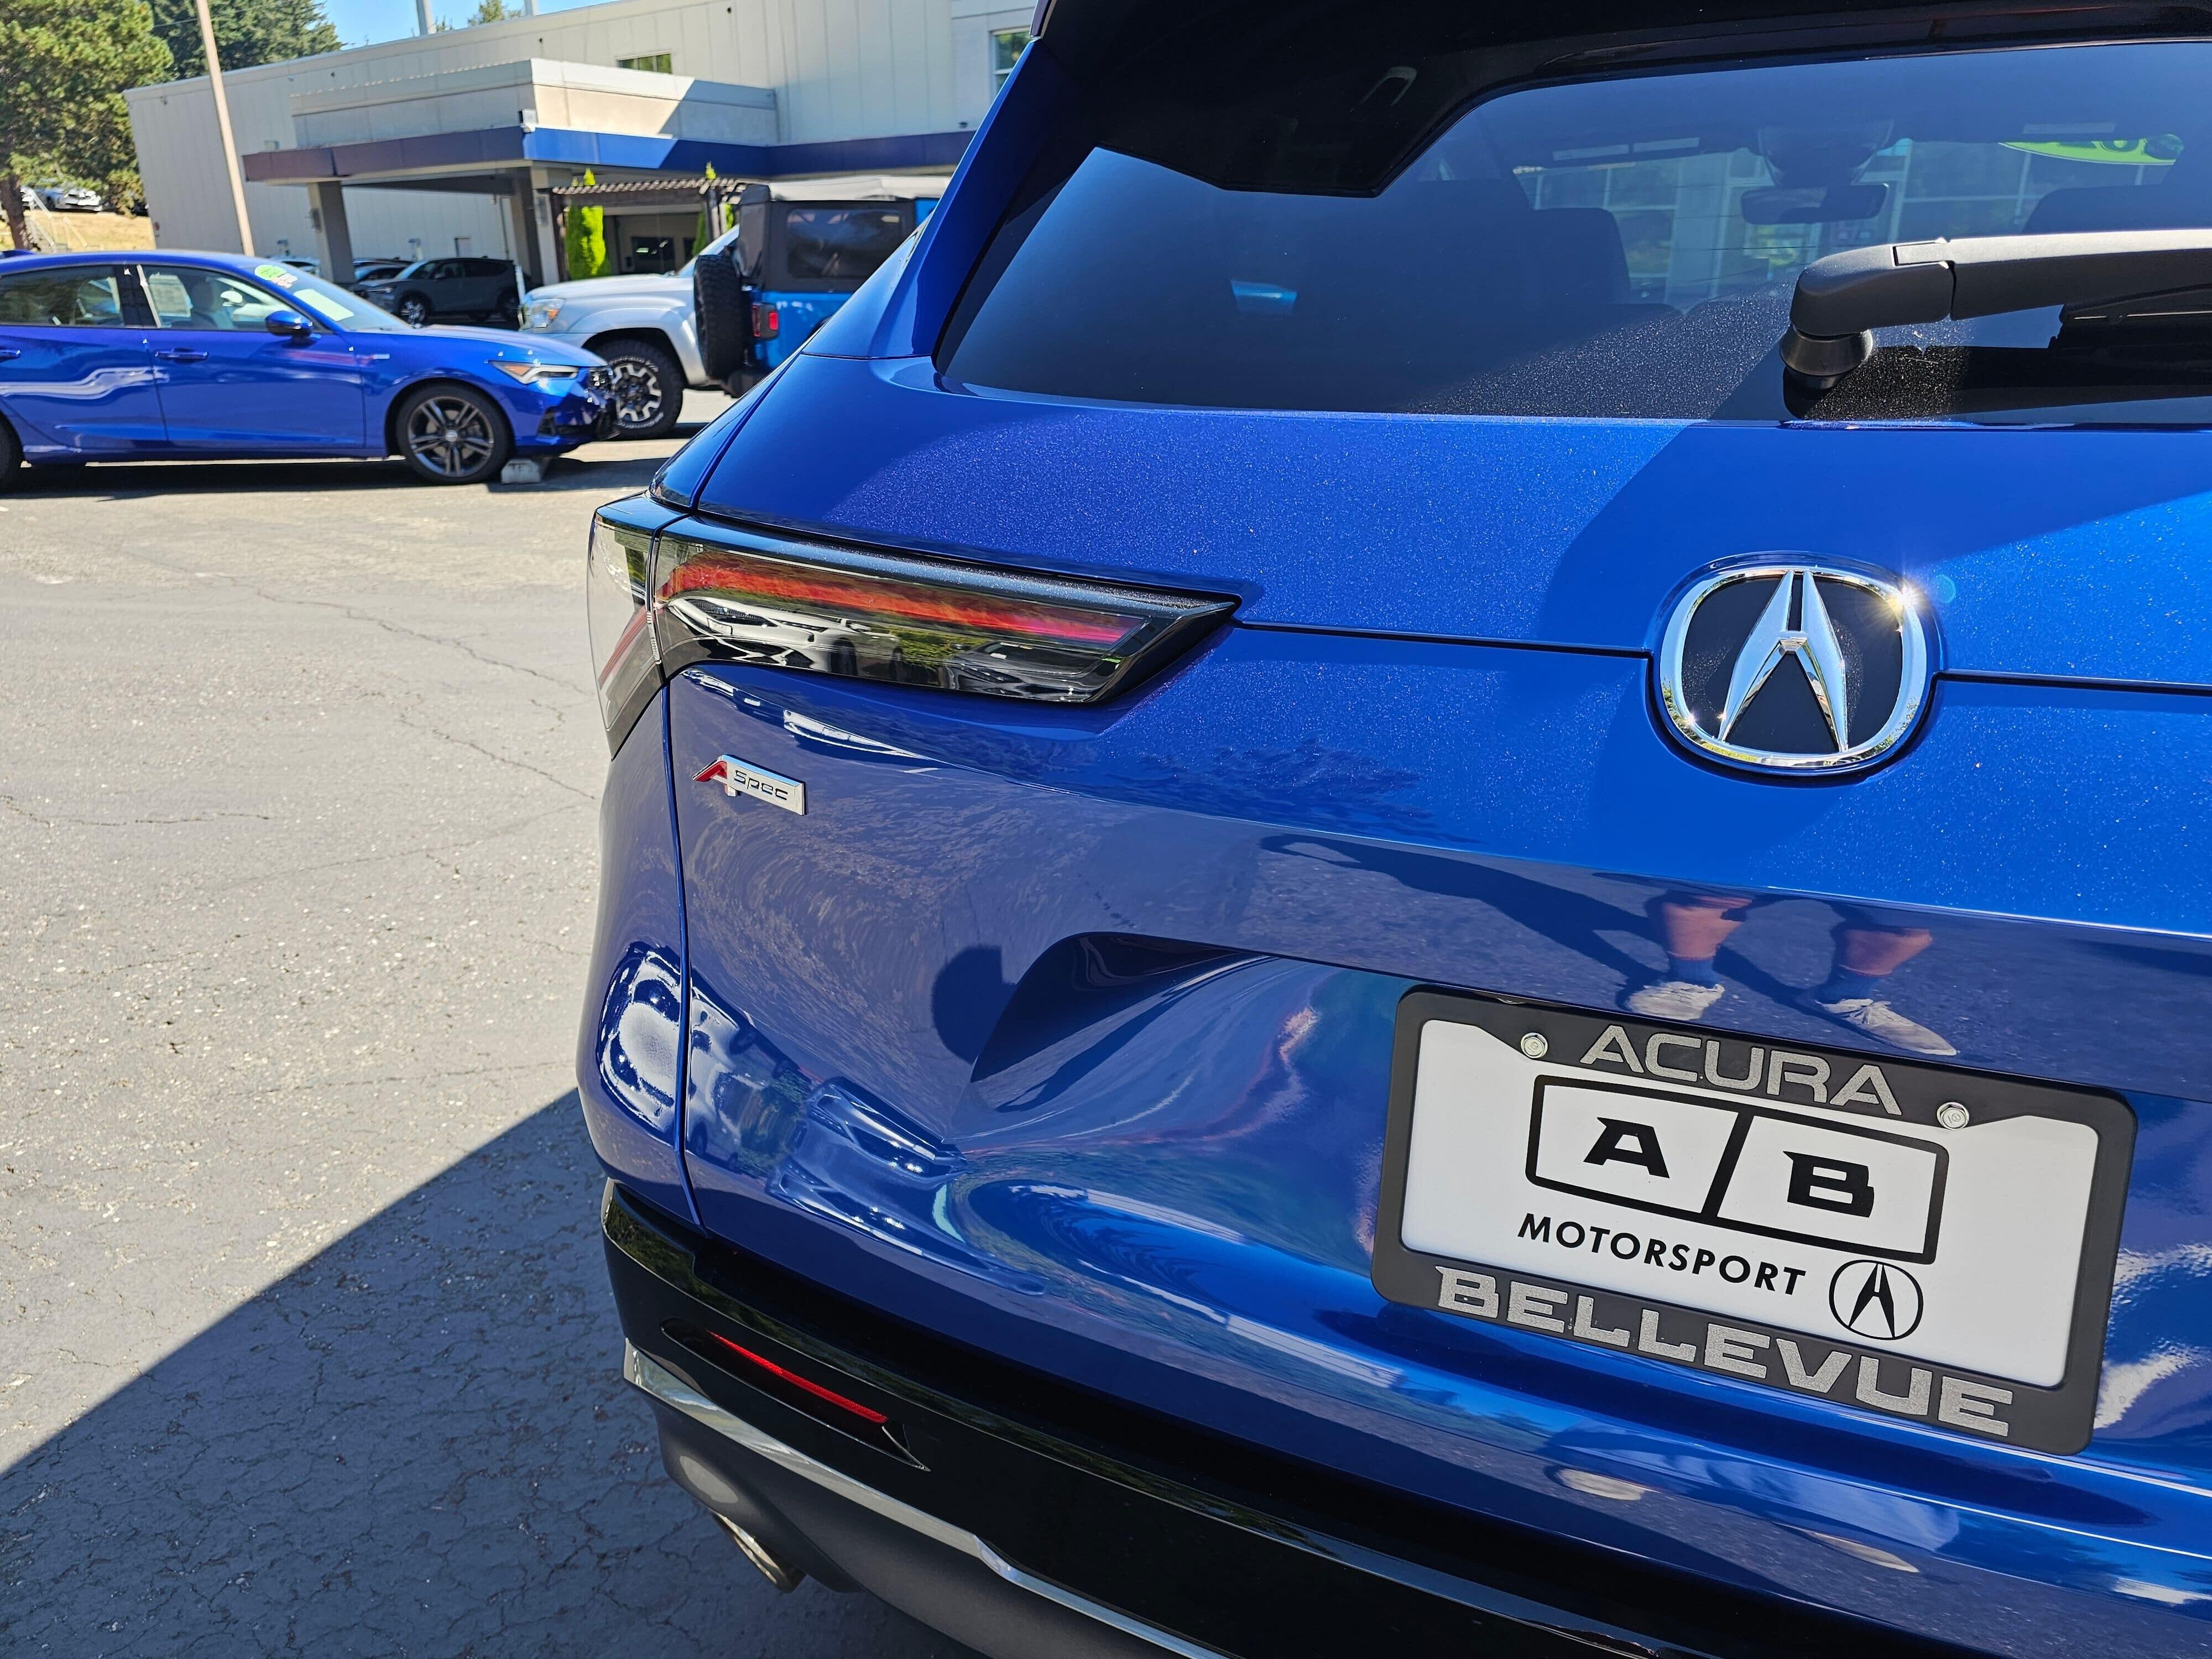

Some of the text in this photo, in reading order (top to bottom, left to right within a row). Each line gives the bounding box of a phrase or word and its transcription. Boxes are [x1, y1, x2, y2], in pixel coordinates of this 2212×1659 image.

[1580, 1025, 1902, 1115] ACURA
[1583, 1117, 1875, 1218] A B
[1517, 1213, 1807, 1296] MOTORSPORT
[1435, 1265, 2014, 1437] BELLEVUE
